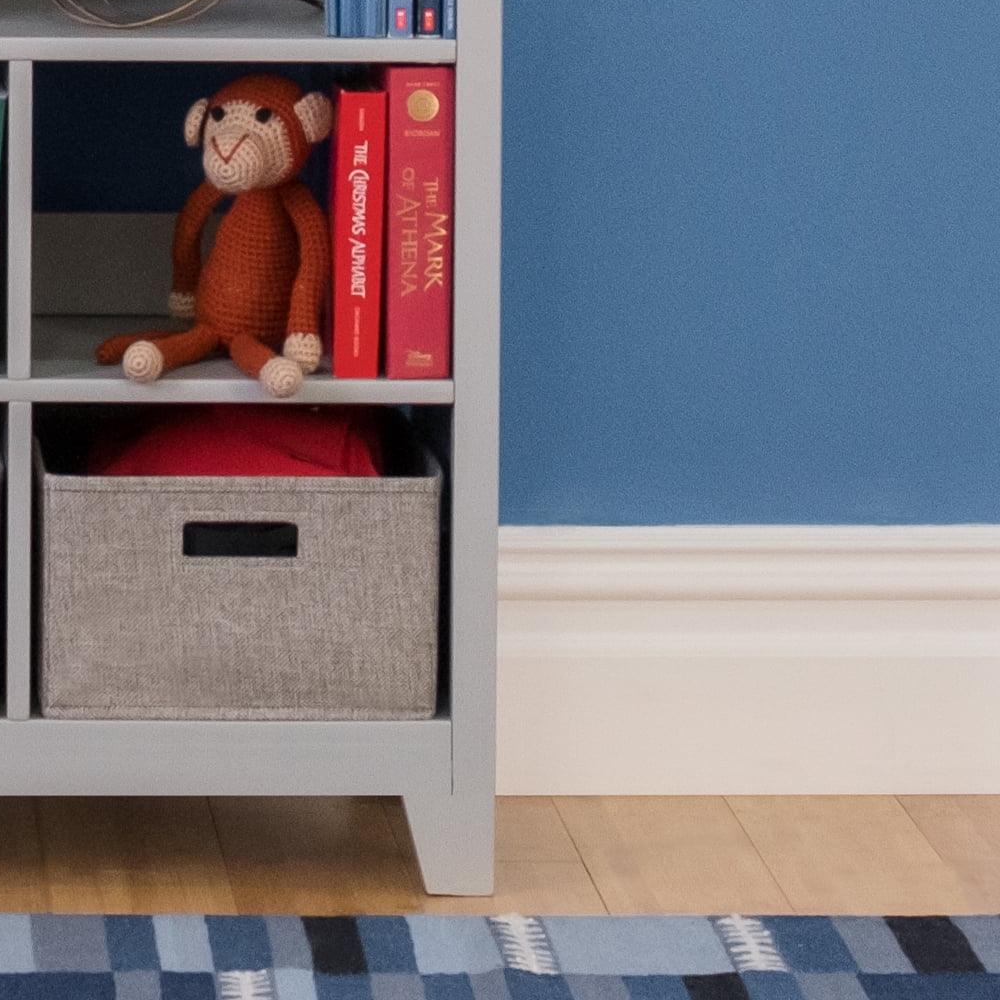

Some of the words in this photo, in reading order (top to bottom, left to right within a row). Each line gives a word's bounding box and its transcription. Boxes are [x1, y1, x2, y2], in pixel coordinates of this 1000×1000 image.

[353, 140, 369, 166] THE
[401, 167, 416, 191] OF
[348, 169, 370, 235] CHRISTMAS
[422, 176, 439, 209] THE
[348, 237, 366, 299] ALPHABET
[395, 193, 421, 297] ATHENA
[422, 211, 449, 292] MARK
